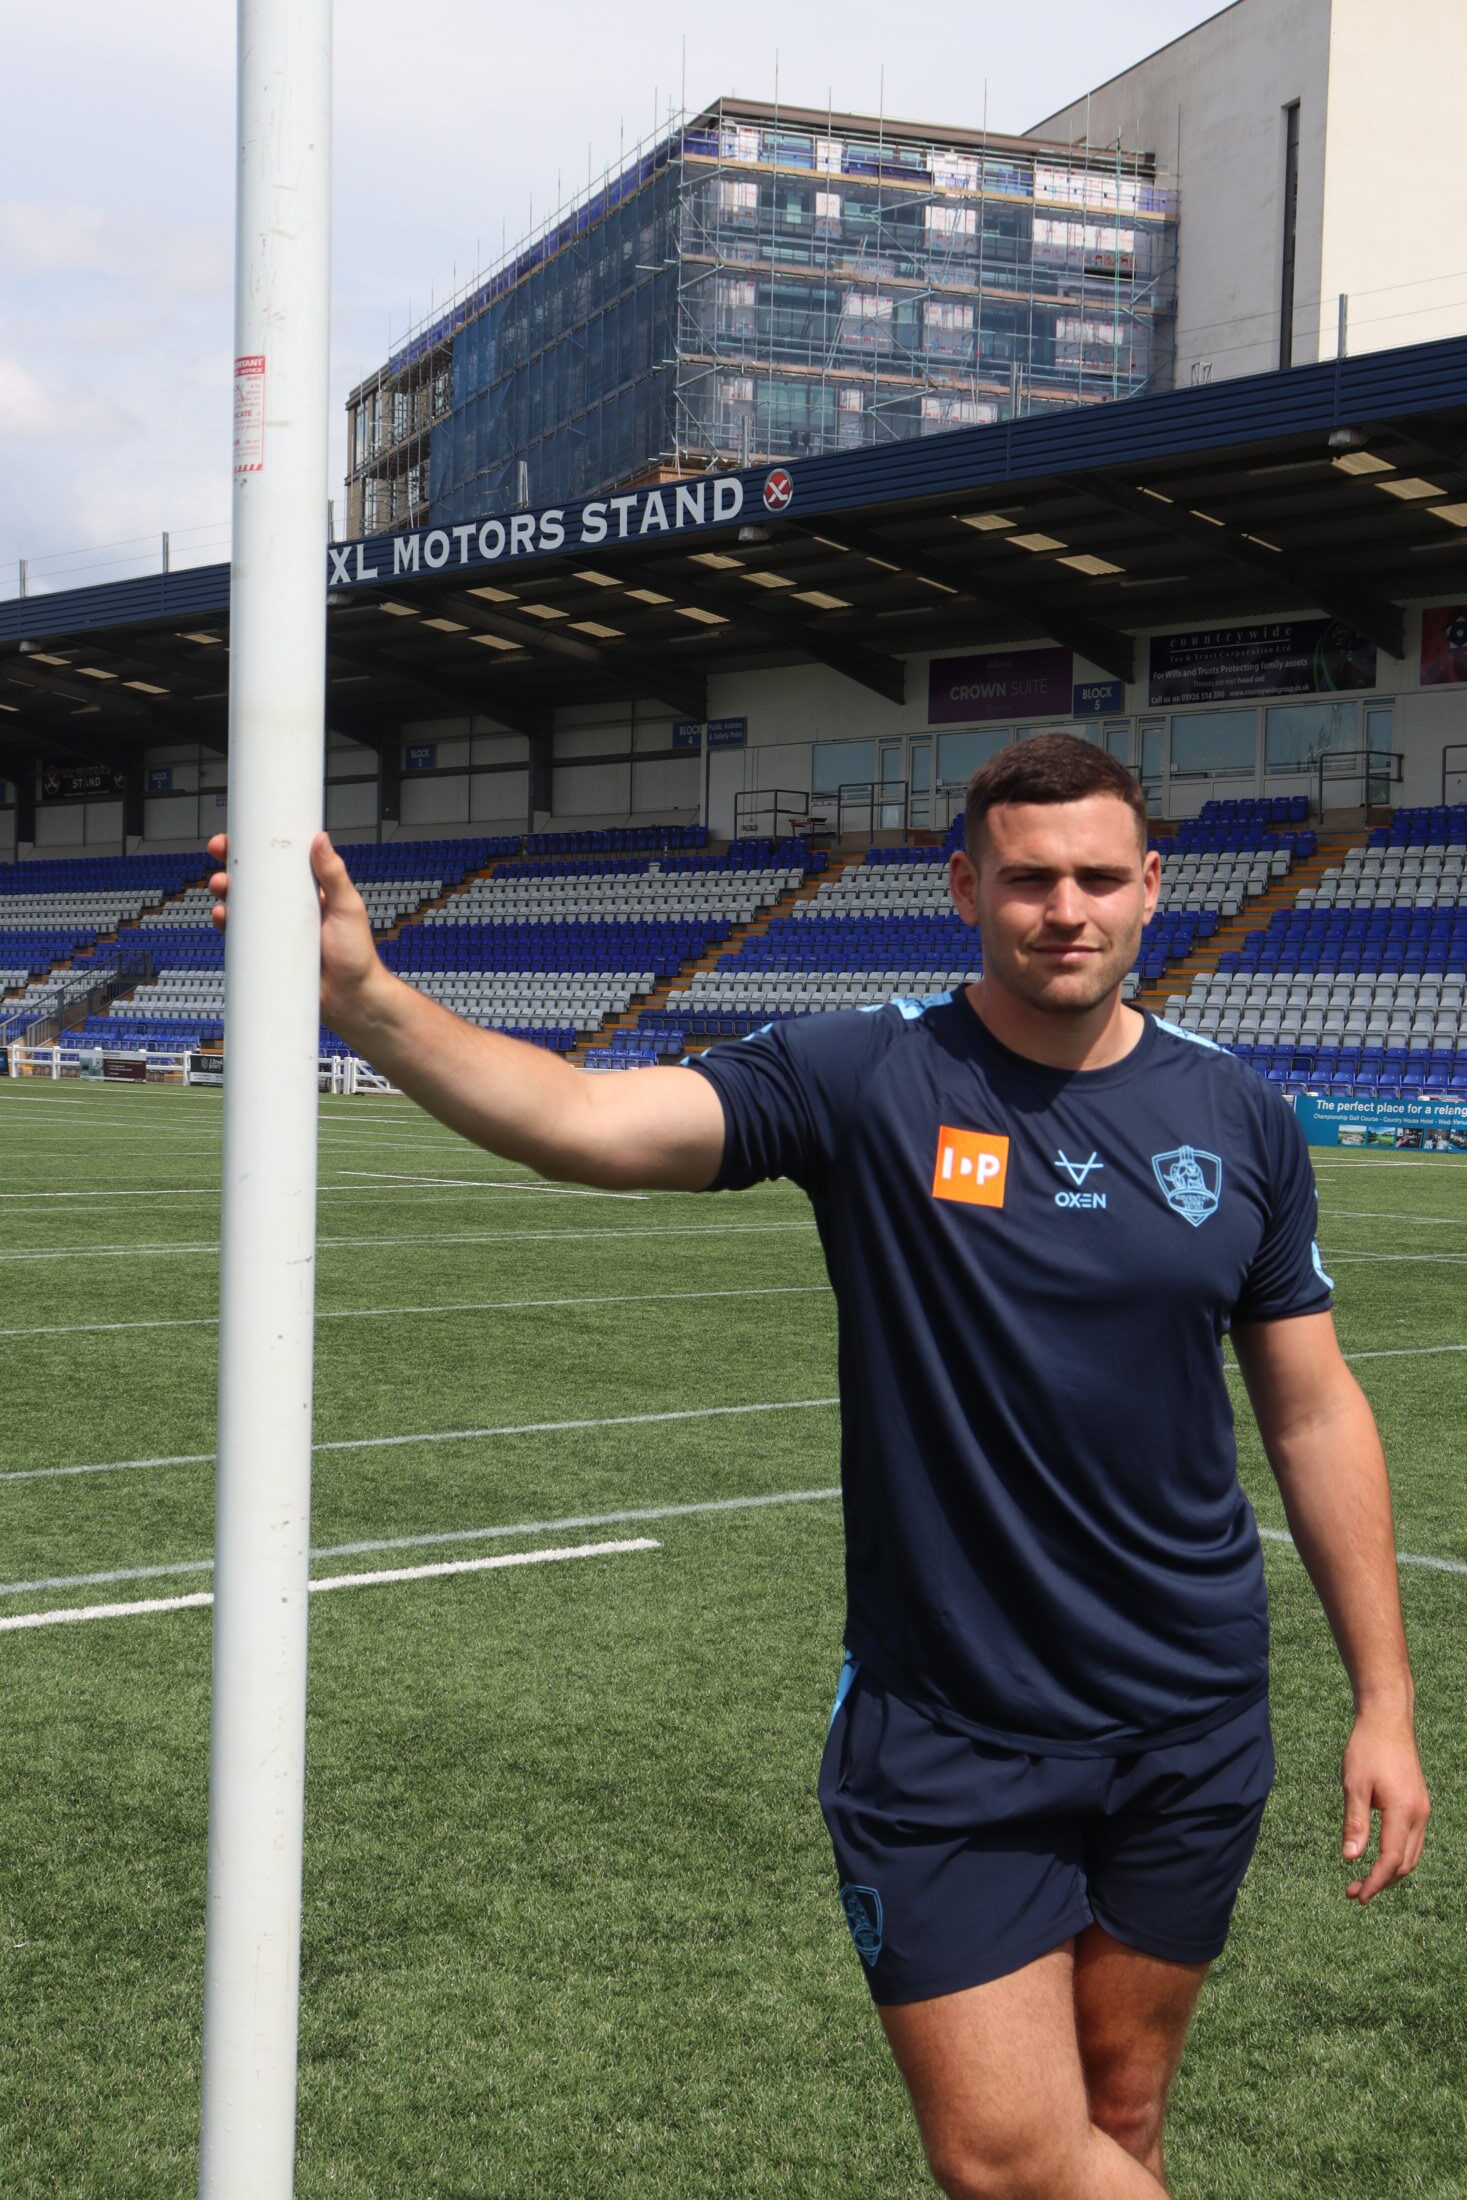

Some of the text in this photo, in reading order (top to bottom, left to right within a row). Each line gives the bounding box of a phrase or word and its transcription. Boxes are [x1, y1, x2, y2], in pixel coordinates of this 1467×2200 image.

[328, 477, 743, 586] XL MOTORS STAND
[1170, 625, 1292, 648] countrywide
[1153, 658, 1308, 680] For Wills and Trusts Protecting family assets
[950, 678, 1049, 701] CROWN SUITE
[1082, 686, 1113, 700] BLOCK
[1151, 695, 1162, 704] Call
[1201, 691, 1212, 700] 514
[1212, 690, 1225, 699] 390
[1094, 699, 1101, 711] 5
[687, 735, 693, 745] 4
[410, 748, 430, 759] BLOCK
[417, 758, 423, 768] 3
[72, 776, 101, 789] STAND
[1316, 1100, 1334, 1110] The
[1337, 1102, 1374, 1112] perfect
[1377, 1103, 1404, 1114] place
[1407, 1104, 1423, 1114] for
[1424, 1106, 1431, 1115] a
[1313, 1113, 1348, 1122] Championship
[1383, 1116, 1402, 1124] Country
[1055, 1191, 1107, 1208] OXEN
